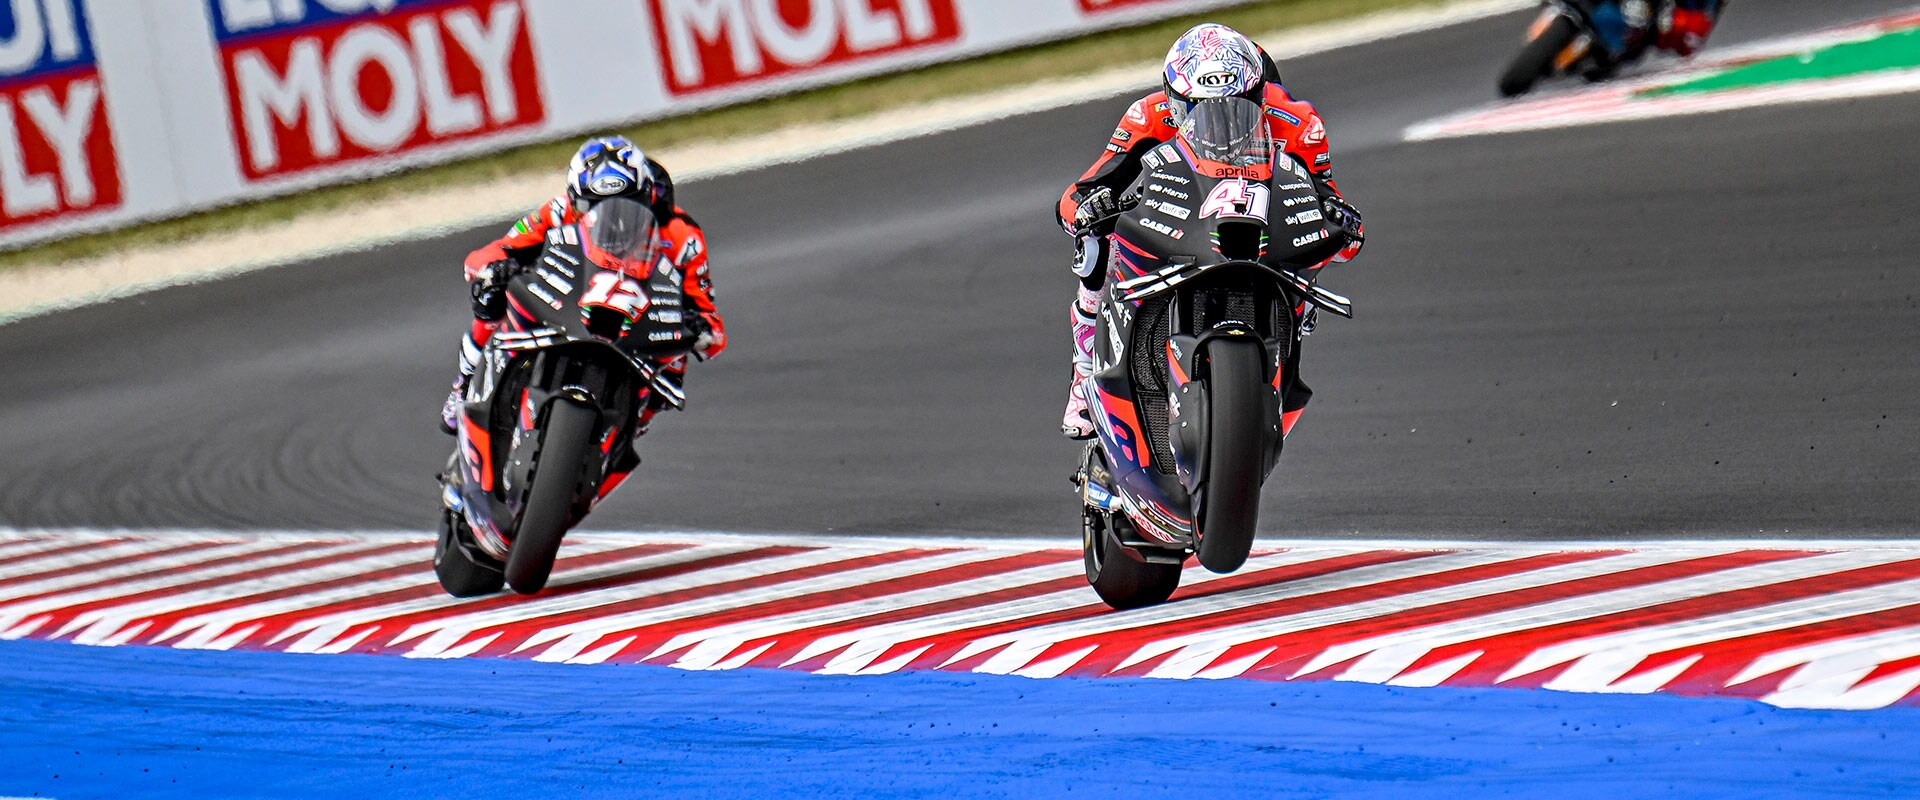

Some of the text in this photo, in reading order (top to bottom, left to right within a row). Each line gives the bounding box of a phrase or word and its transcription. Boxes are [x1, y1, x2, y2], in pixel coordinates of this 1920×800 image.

[234, 4, 520, 170] MOLY
[1199, 73, 1235, 86] KYT
[1215, 167, 1260, 179] aprilia
[1162, 186, 1189, 200] Marsh
[1145, 199, 1161, 210] sky
[1198, 178, 1271, 226] 41
[1139, 217, 1173, 236] CASE
[1285, 215, 1298, 225] sky
[1292, 231, 1320, 247] CASE
[578, 271, 652, 322] 12
